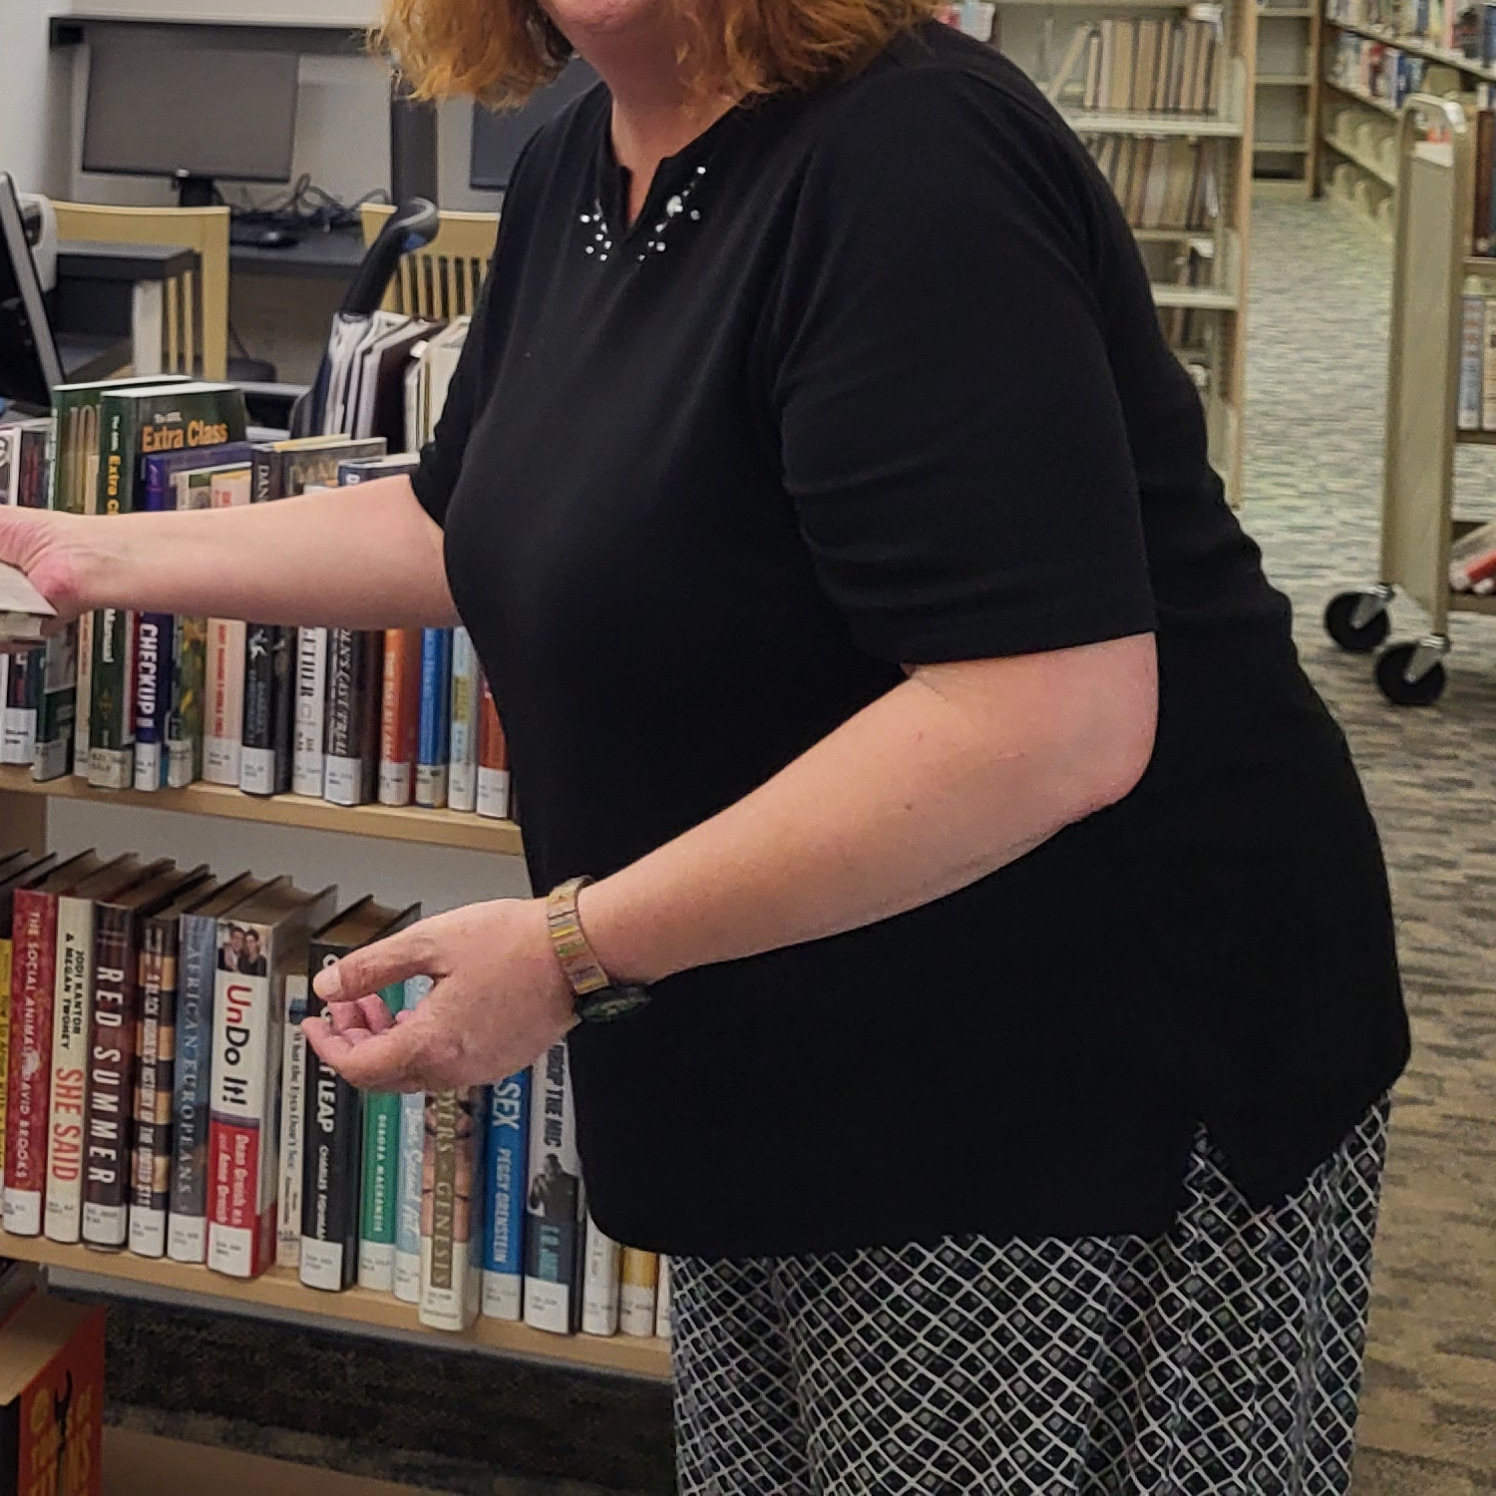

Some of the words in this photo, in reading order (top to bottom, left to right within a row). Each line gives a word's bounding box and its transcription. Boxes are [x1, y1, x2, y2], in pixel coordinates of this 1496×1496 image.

[142, 425, 184, 453] Extra
[187, 419, 229, 447] Class
[108, 455, 121, 495] Extra
[137, 623, 158, 715] CHECKUP
[28, 911, 40, 936] THE
[26, 942, 38, 991] SOCIAL
[63, 947, 74, 993] MEGAN
[74, 950, 86, 979] JODI
[73, 982, 84, 1035] KANTOR
[96, 965, 124, 1027] RED
[185, 946, 200, 1052] AFRICAN
[60, 998, 72, 1050] TWOHEY
[224, 984, 252, 1066] UnDo
[55, 1067, 82, 1114] SHE
[88, 1045, 121, 1184] SUMMER
[223, 1075, 247, 1107] It!
[317, 1079, 336, 1133] LEAP
[492, 1081, 521, 1130] SEX
[16, 1119, 29, 1179] BROOKS
[52, 1123, 80, 1182] SAID
[178, 1058, 198, 1195] EUROPEANS
[317, 1145, 330, 1191] CHARLES
[496, 1146, 511, 1192] PEGGY
[434, 1181, 451, 1285] GENESIS
[495, 1192, 510, 1263] ORENSTEIN
